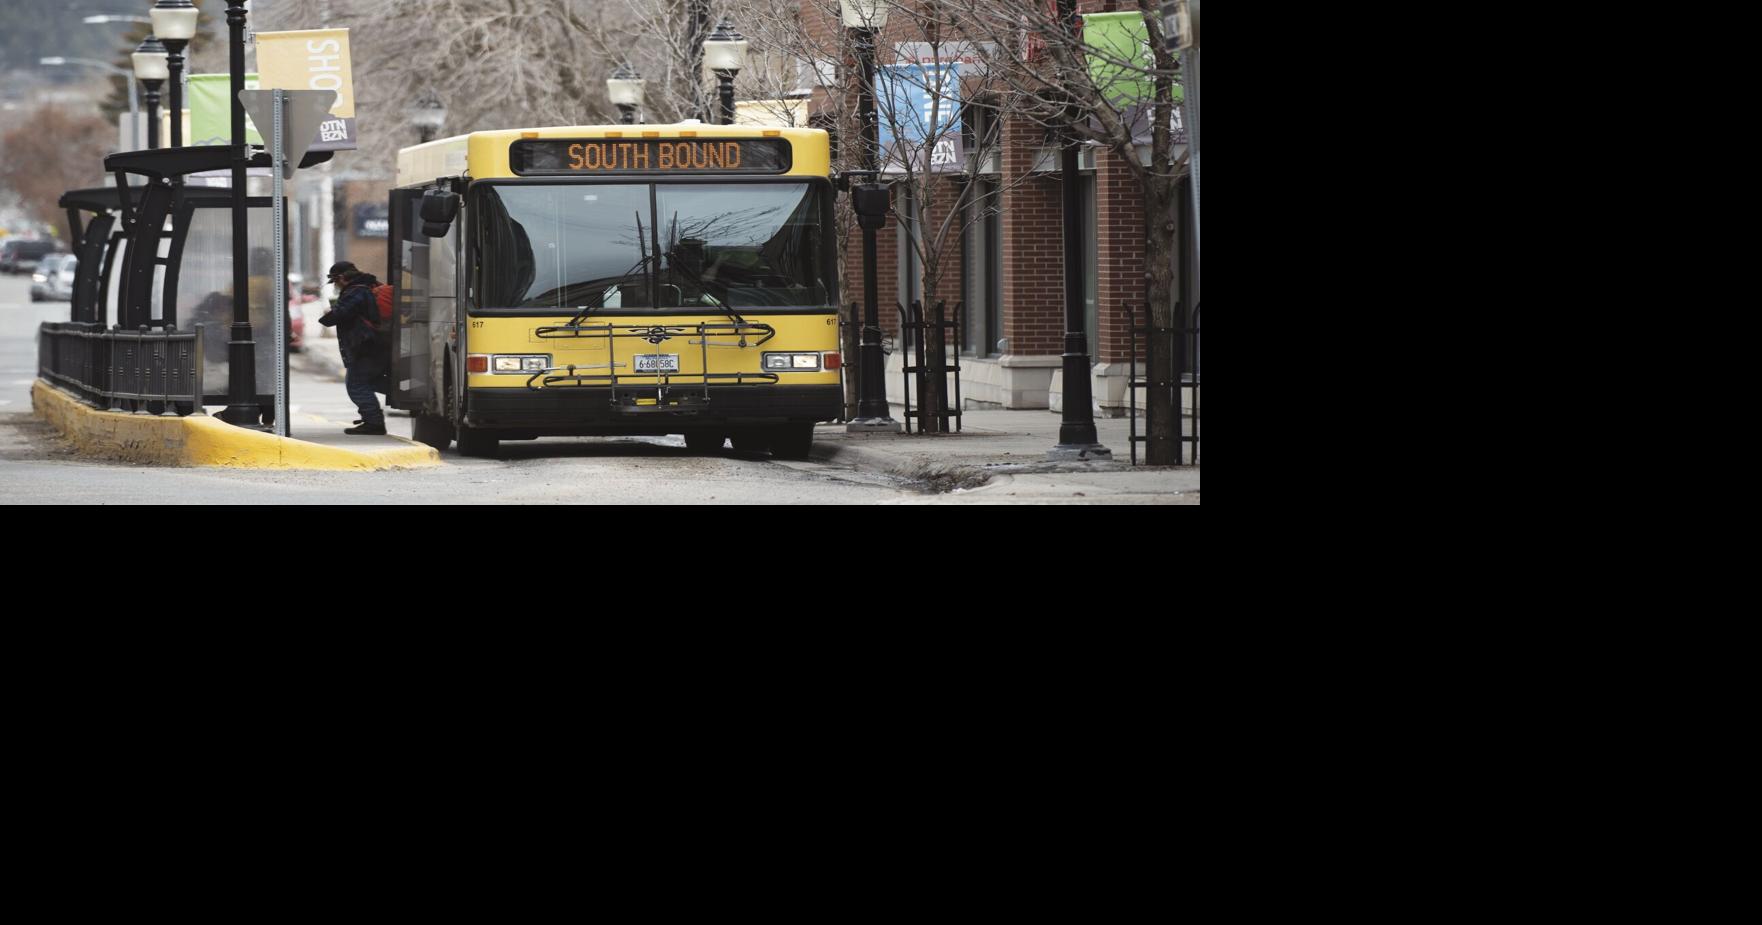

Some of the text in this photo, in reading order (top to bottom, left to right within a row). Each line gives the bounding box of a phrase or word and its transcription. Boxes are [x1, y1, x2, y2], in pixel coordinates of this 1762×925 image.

[320, 119, 346, 131] DTN
[320, 129, 348, 142] BZN
[568, 142, 741, 170] SOUTH BOUND
